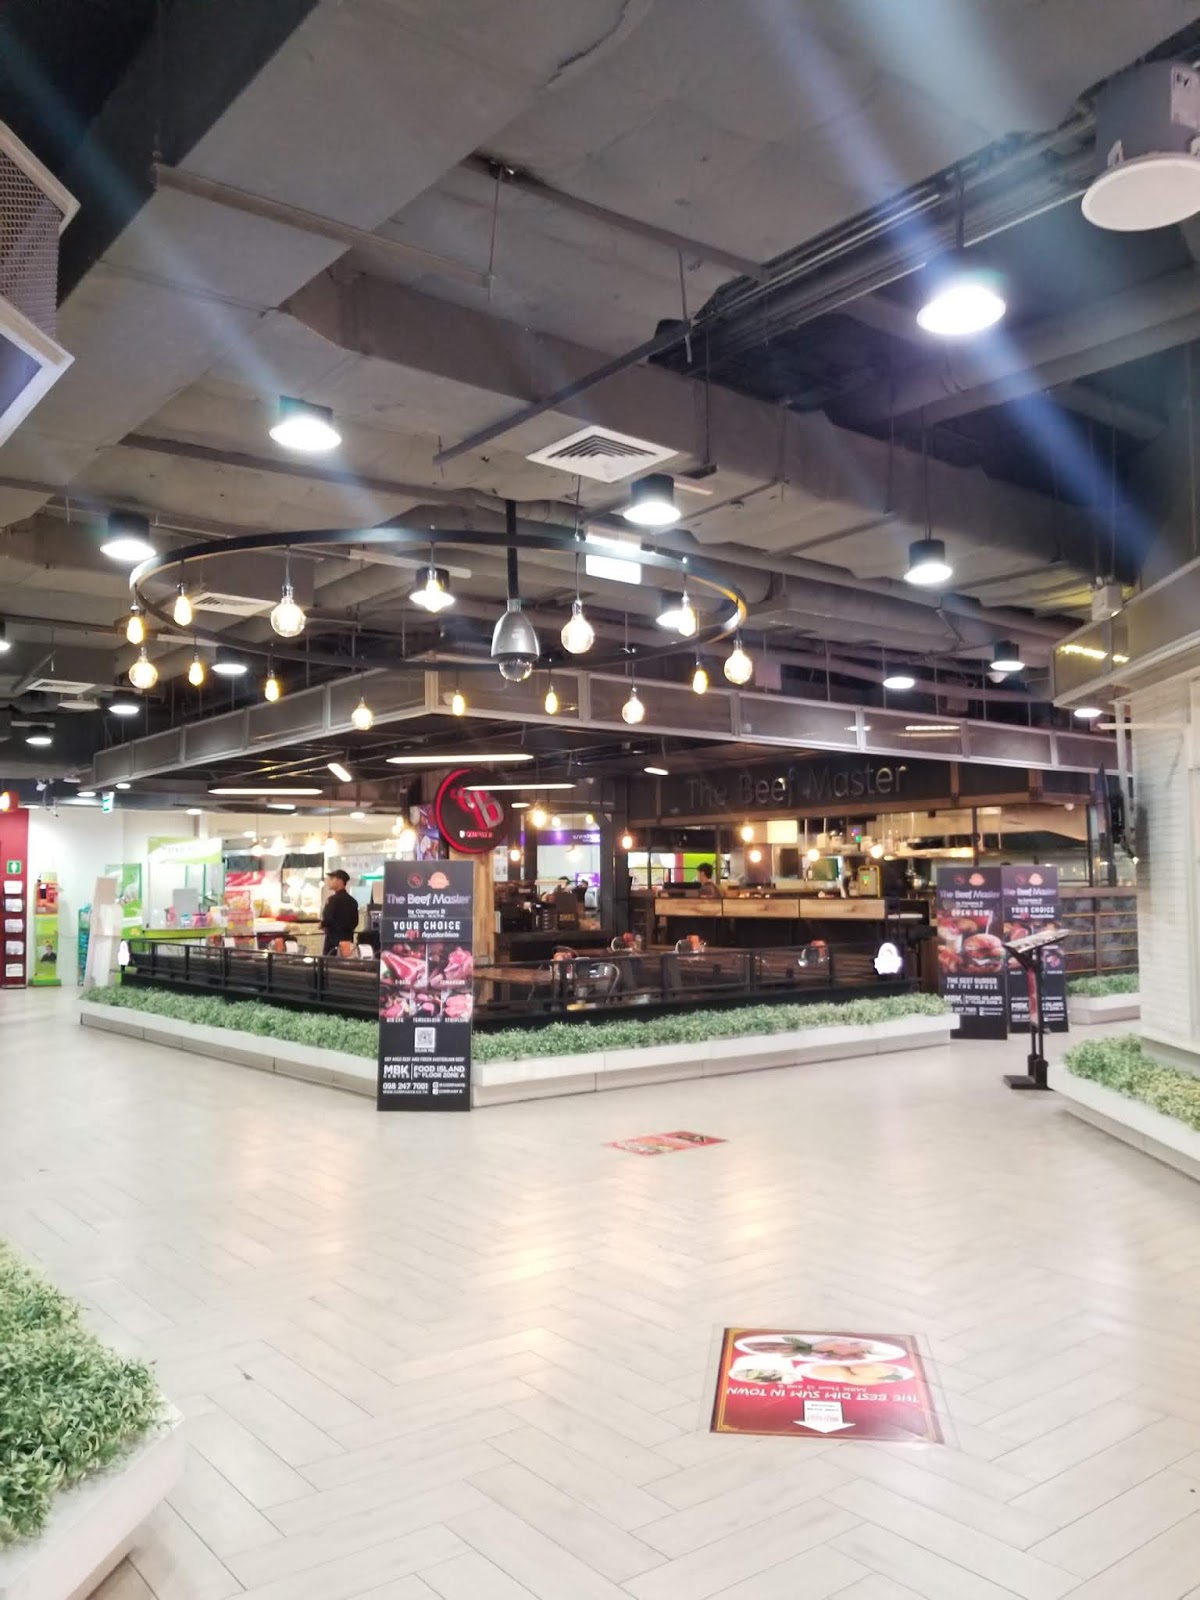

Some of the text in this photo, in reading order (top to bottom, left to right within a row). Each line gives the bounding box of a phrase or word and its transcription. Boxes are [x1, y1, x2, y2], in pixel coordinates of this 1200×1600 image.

[687, 764, 906, 809] The Beef Master
[954, 890, 972, 899] Beef
[973, 890, 1000, 898] Master
[387, 893, 471, 906] The Beef Master
[393, 921, 461, 930] YOUR CHOICE
[383, 1065, 409, 1074] MBK
[398, 1082, 411, 1090] 247
[412, 1082, 428, 1090] 7001
[726, 1386, 920, 1402] THE BEST DIM SUM IN TOWN
